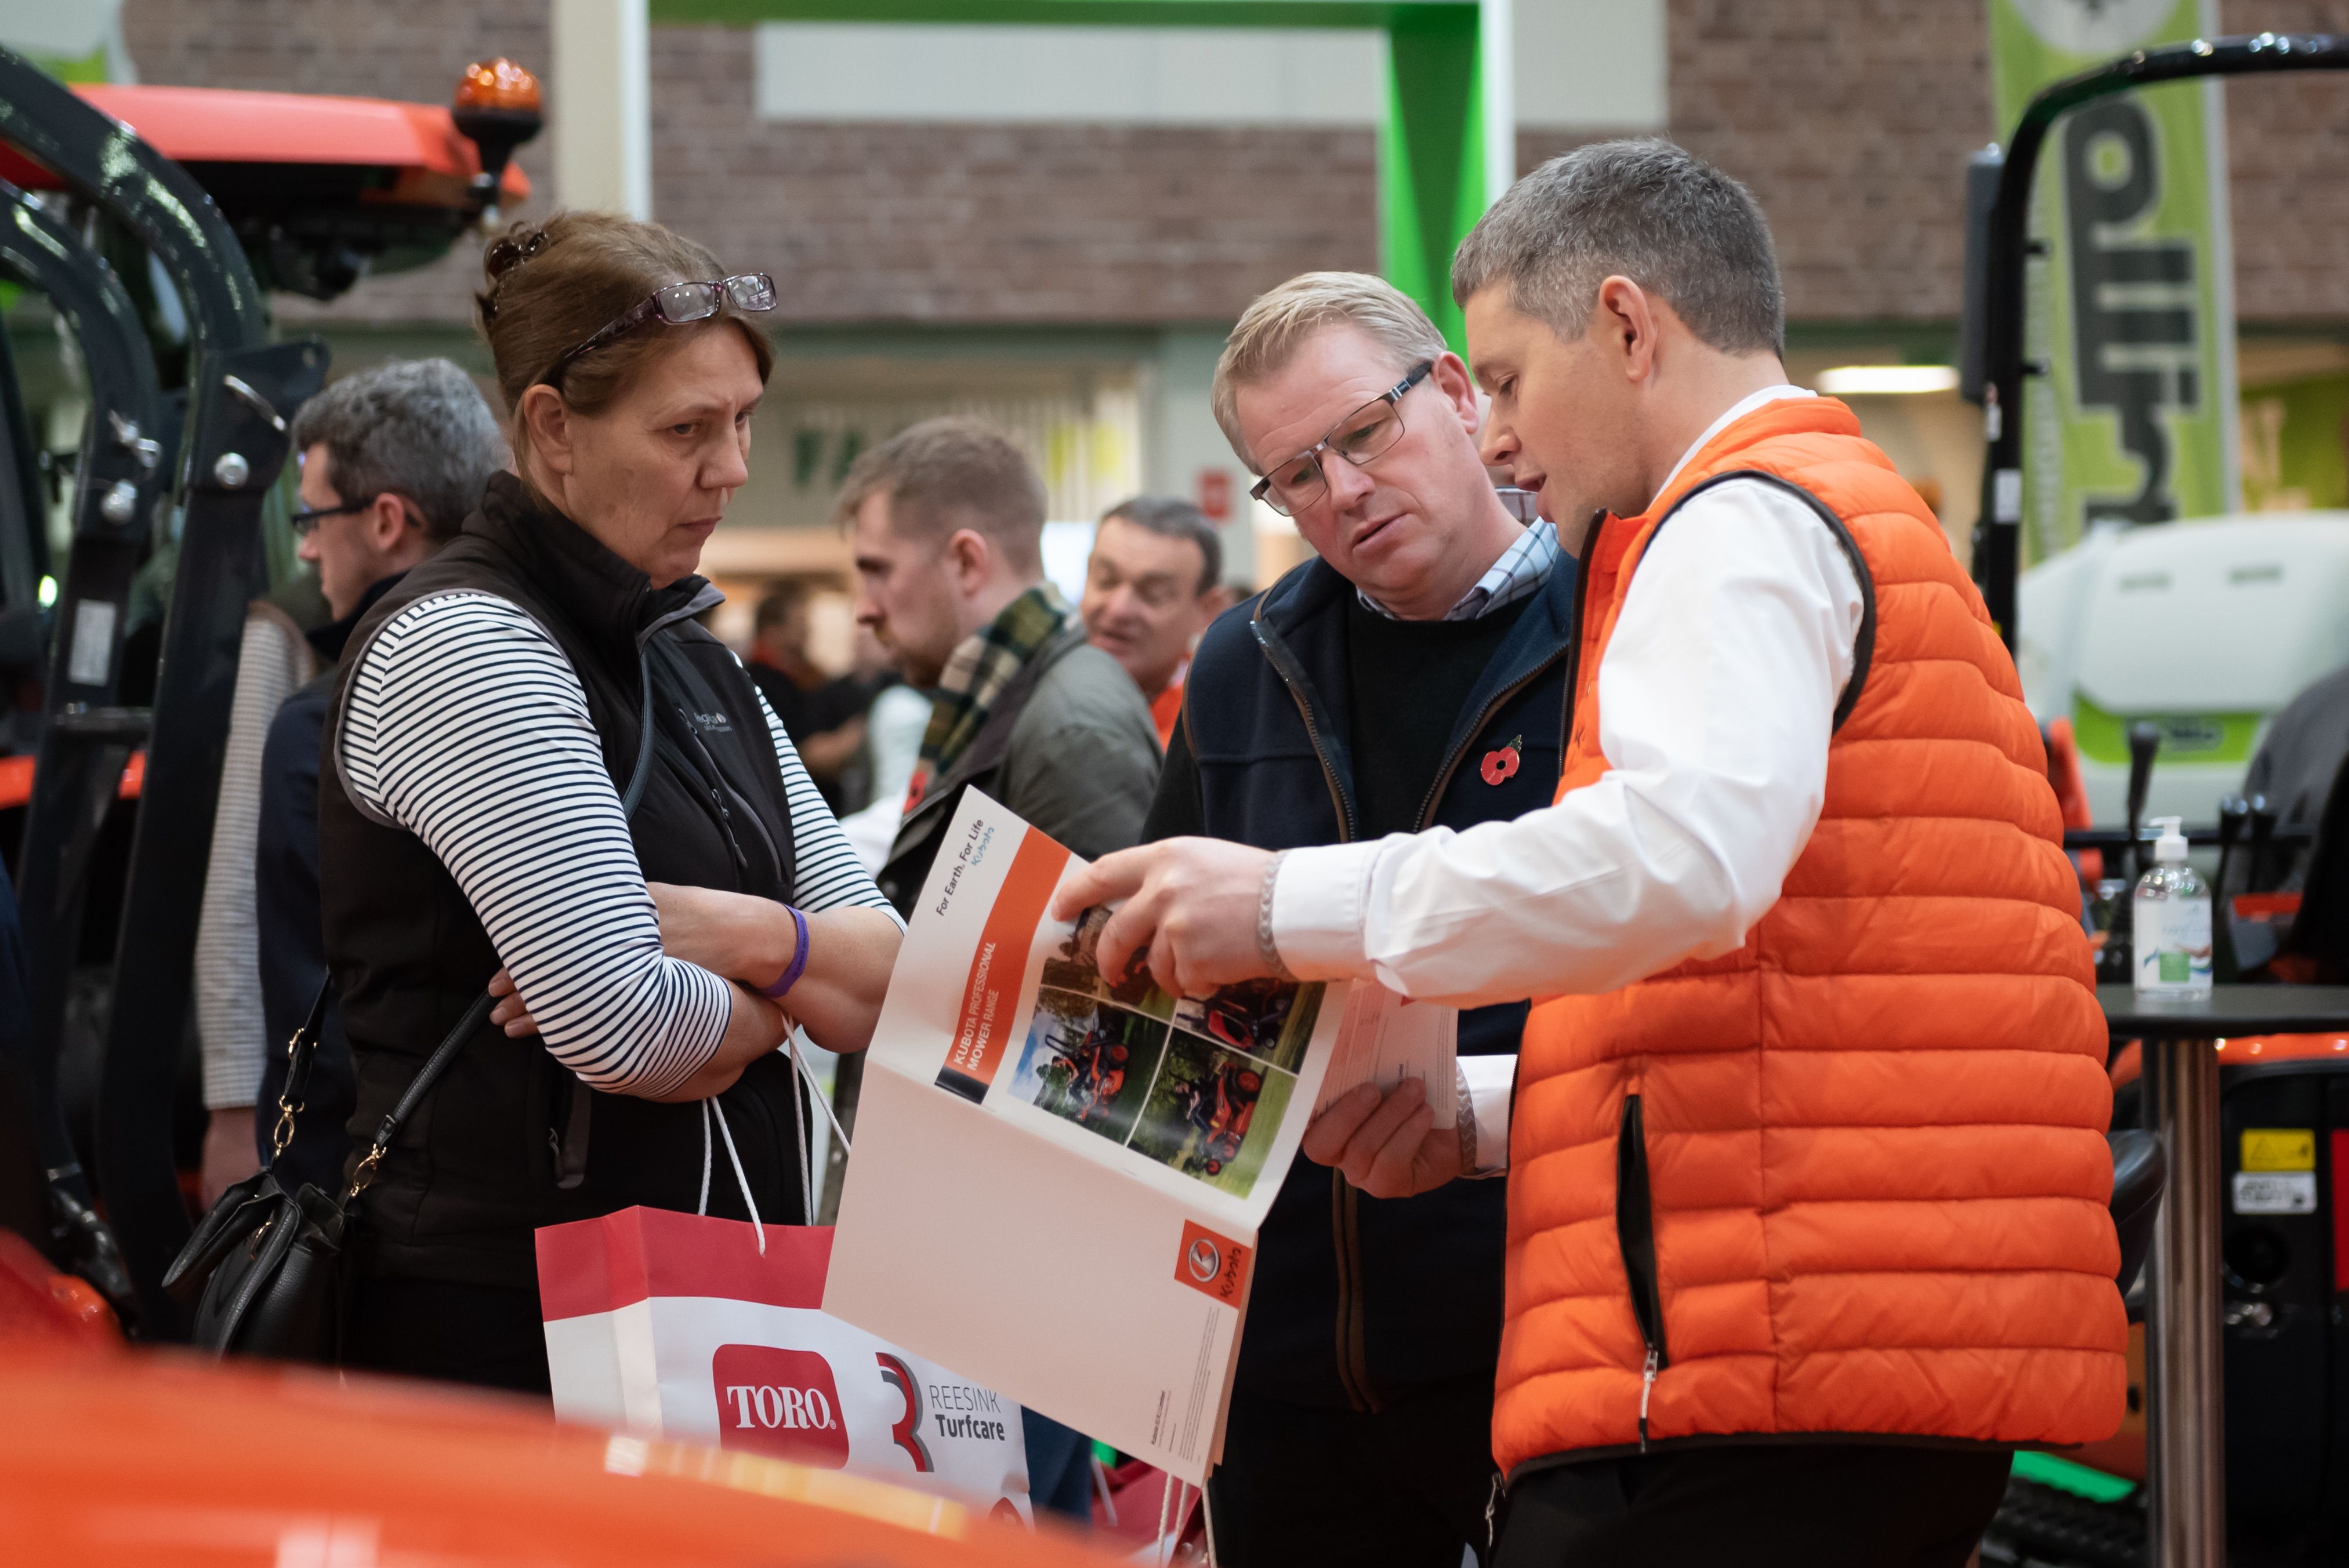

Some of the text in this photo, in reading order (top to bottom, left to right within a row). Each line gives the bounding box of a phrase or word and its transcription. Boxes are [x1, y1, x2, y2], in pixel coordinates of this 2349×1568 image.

[936, 897, 949, 916] For
[959, 842, 973, 862] For
[968, 819, 984, 840] Life
[971, 826, 995, 866] Kubota
[954, 942, 996, 1065] KUBOTA PROFESSIONAL
[966, 989, 999, 1071] MOWER RANGE
[1220, 1247, 1242, 1298] Kubota
[929, 1385, 1001, 1414] REESINK
[934, 1414, 1006, 1441] Turfcare
